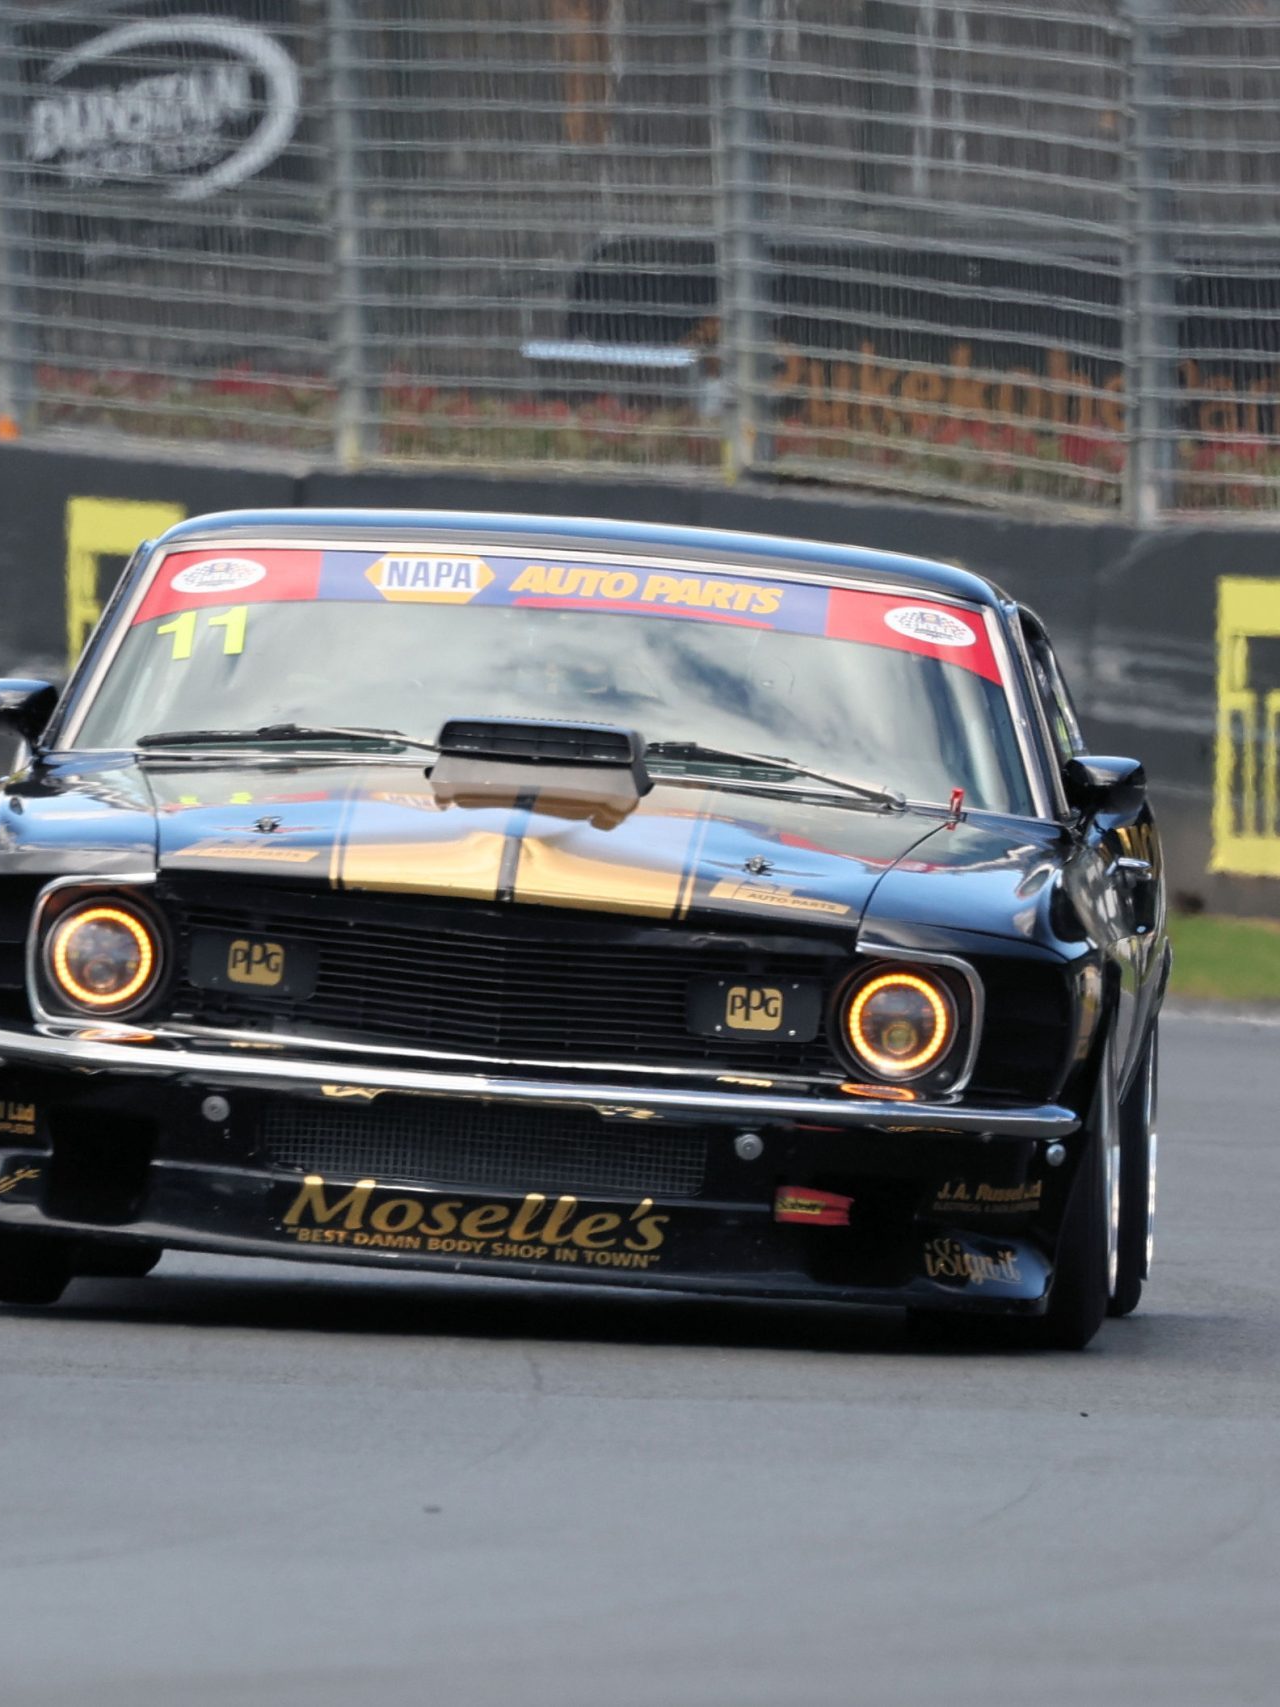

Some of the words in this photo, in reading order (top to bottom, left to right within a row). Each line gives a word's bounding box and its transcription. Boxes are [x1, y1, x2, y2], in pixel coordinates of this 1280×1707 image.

[387, 560, 473, 589] NAPA
[509, 565, 638, 599] AUTO
[640, 575, 784, 614] PARTS
[157, 605, 248, 660] 11
[748, 892, 789, 904] AUTO
[791, 899, 837, 911] PARTS
[231, 941, 281, 975] PPG
[729, 987, 780, 1021] PPG
[283, 1175, 670, 1251] Moselle's
[353, 1233, 422, 1250] DAMN
[427, 1238, 485, 1254] BODY
[491, 1243, 548, 1259] SHOP
[554, 1248, 578, 1262] IN
